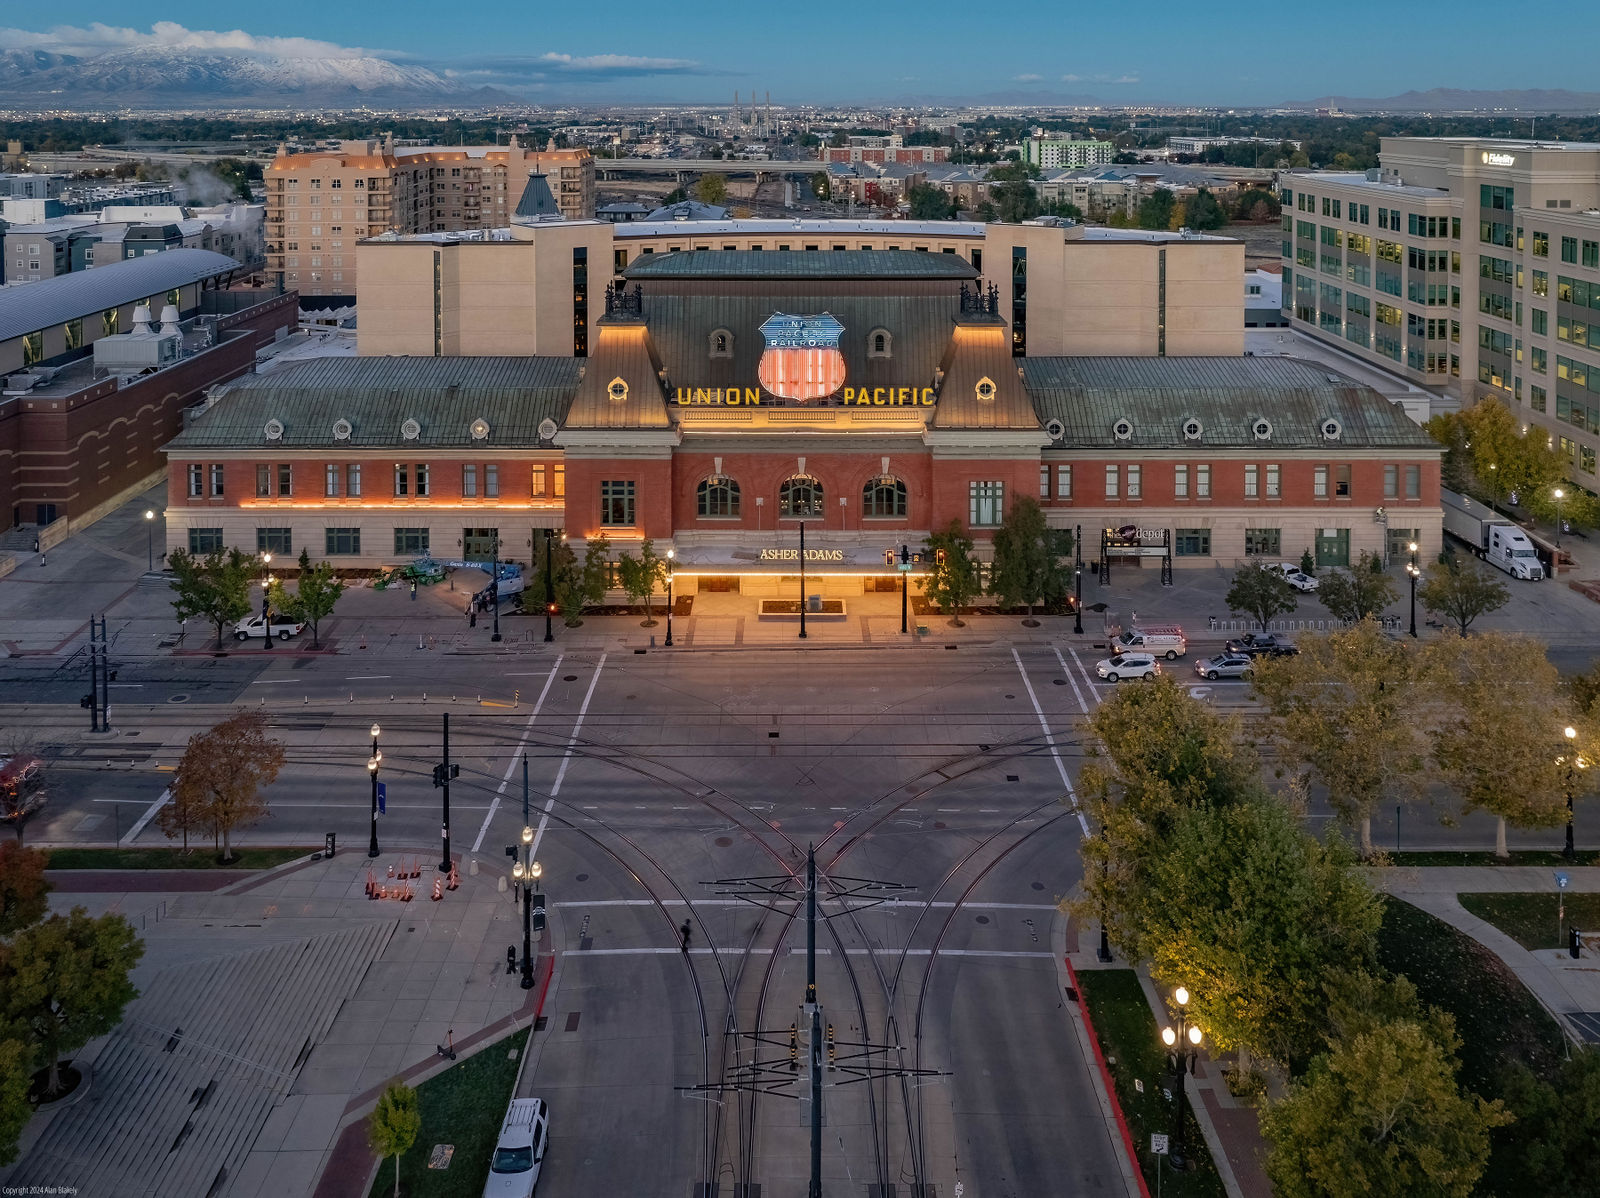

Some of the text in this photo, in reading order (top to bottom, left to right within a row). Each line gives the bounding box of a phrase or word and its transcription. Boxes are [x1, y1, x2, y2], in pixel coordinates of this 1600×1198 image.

[677, 387, 934, 405] UNION PACIFIC
[1136, 528, 1164, 541] depot
[760, 549, 843, 560] ASHER ADAMS
